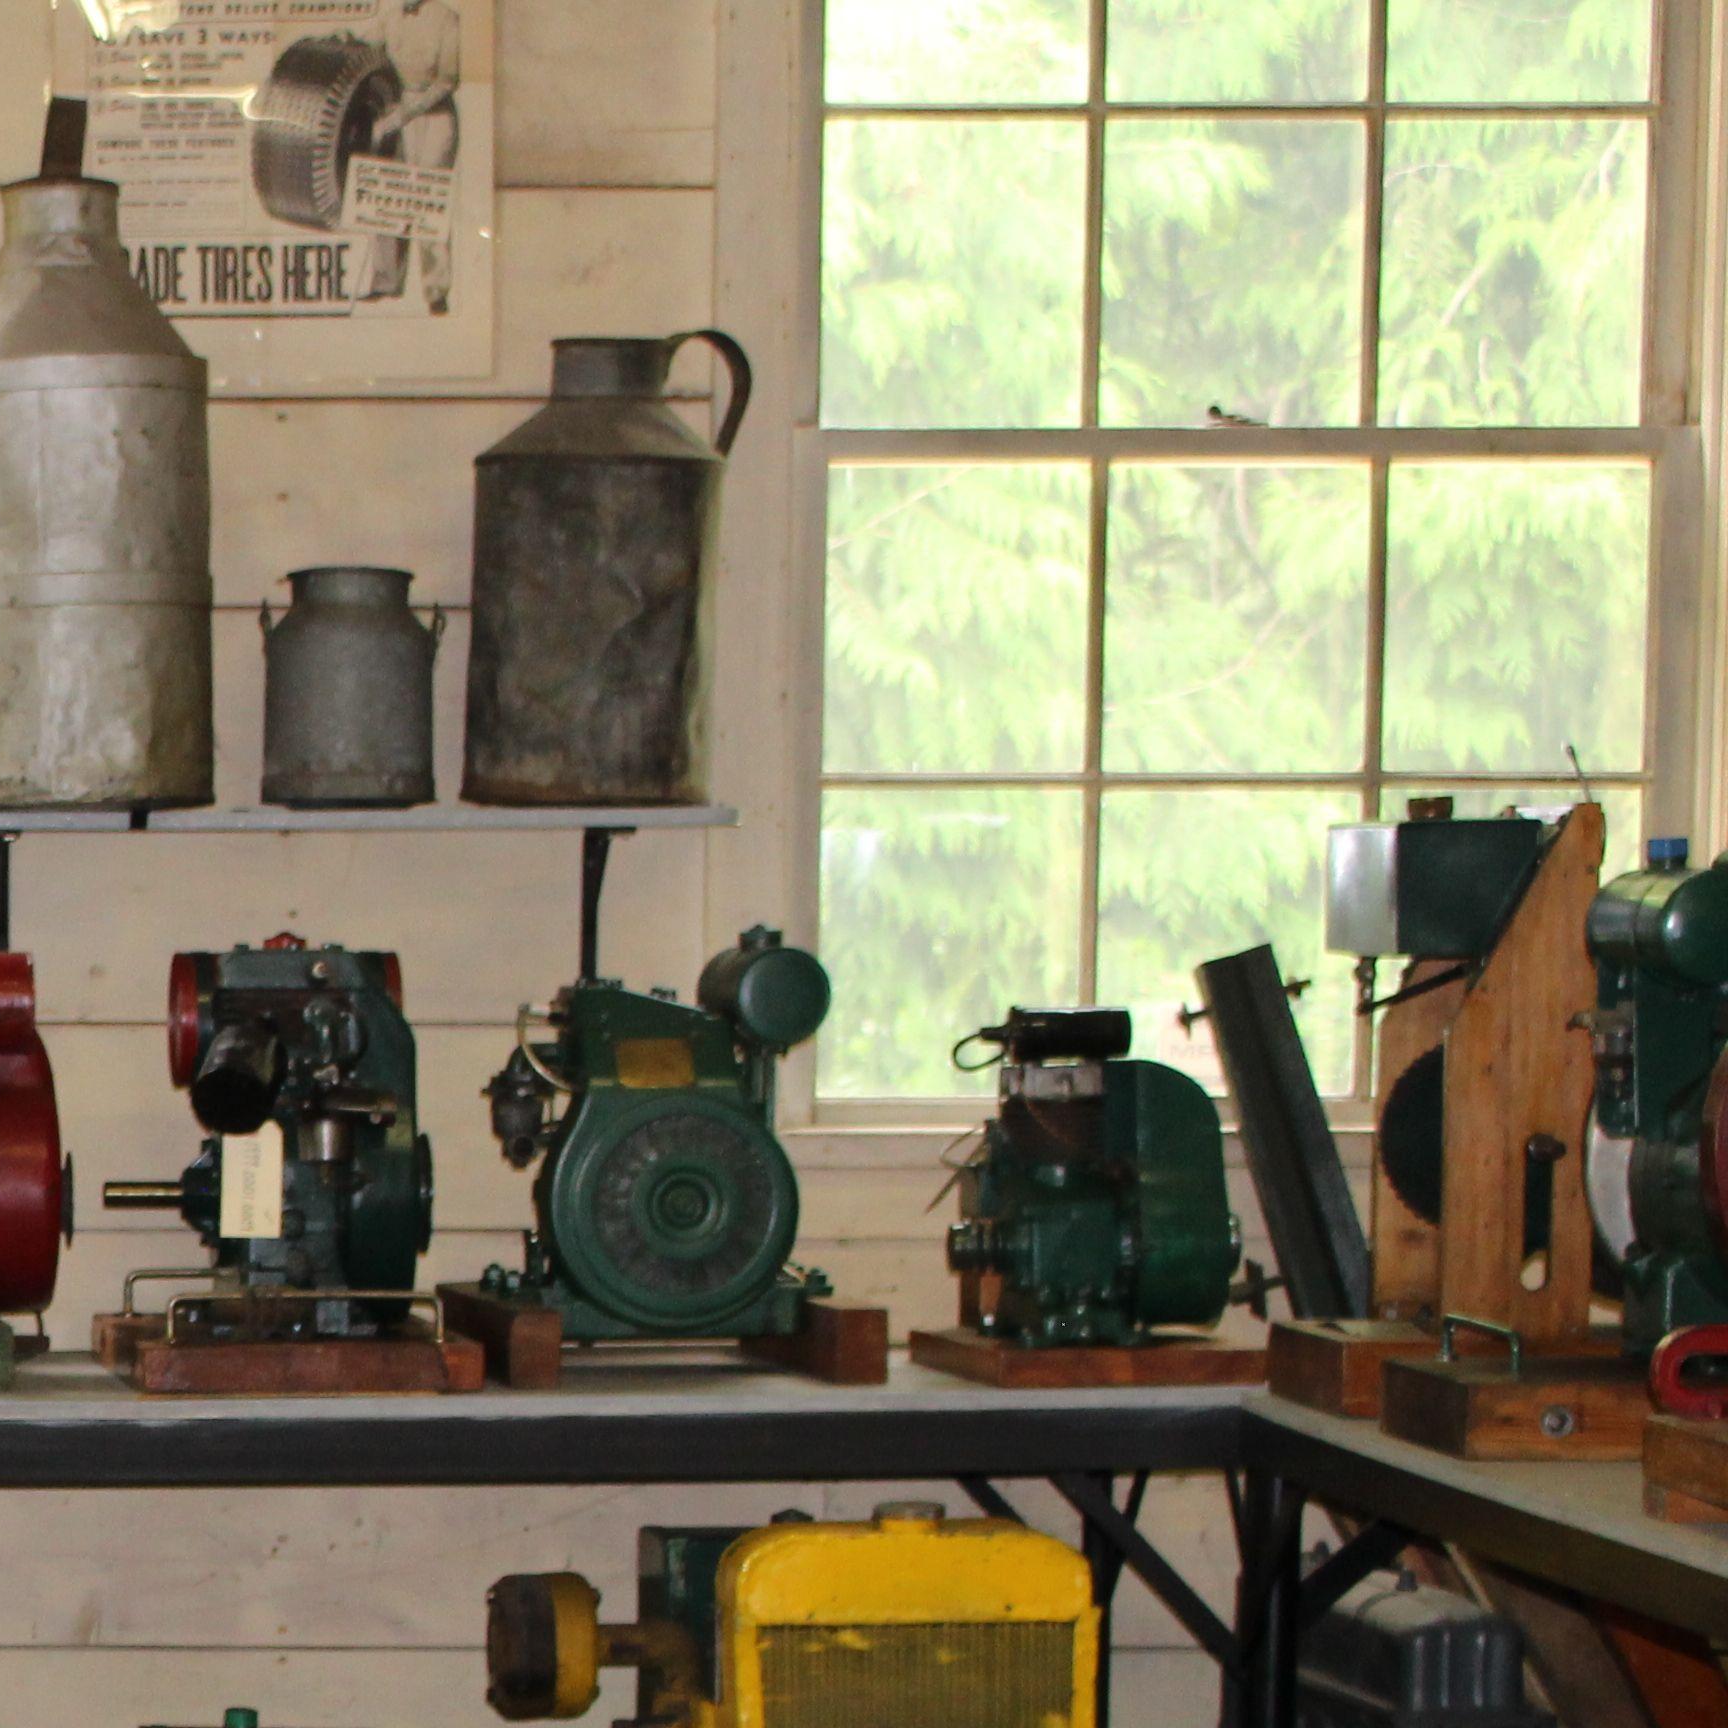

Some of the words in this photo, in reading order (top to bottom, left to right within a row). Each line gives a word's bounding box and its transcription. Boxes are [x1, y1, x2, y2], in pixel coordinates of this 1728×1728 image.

[197, 28, 208, 46] 3
[355, 188, 446, 214] Firestone
[197, 245, 273, 304] TIRES
[282, 243, 351, 303] HERE
